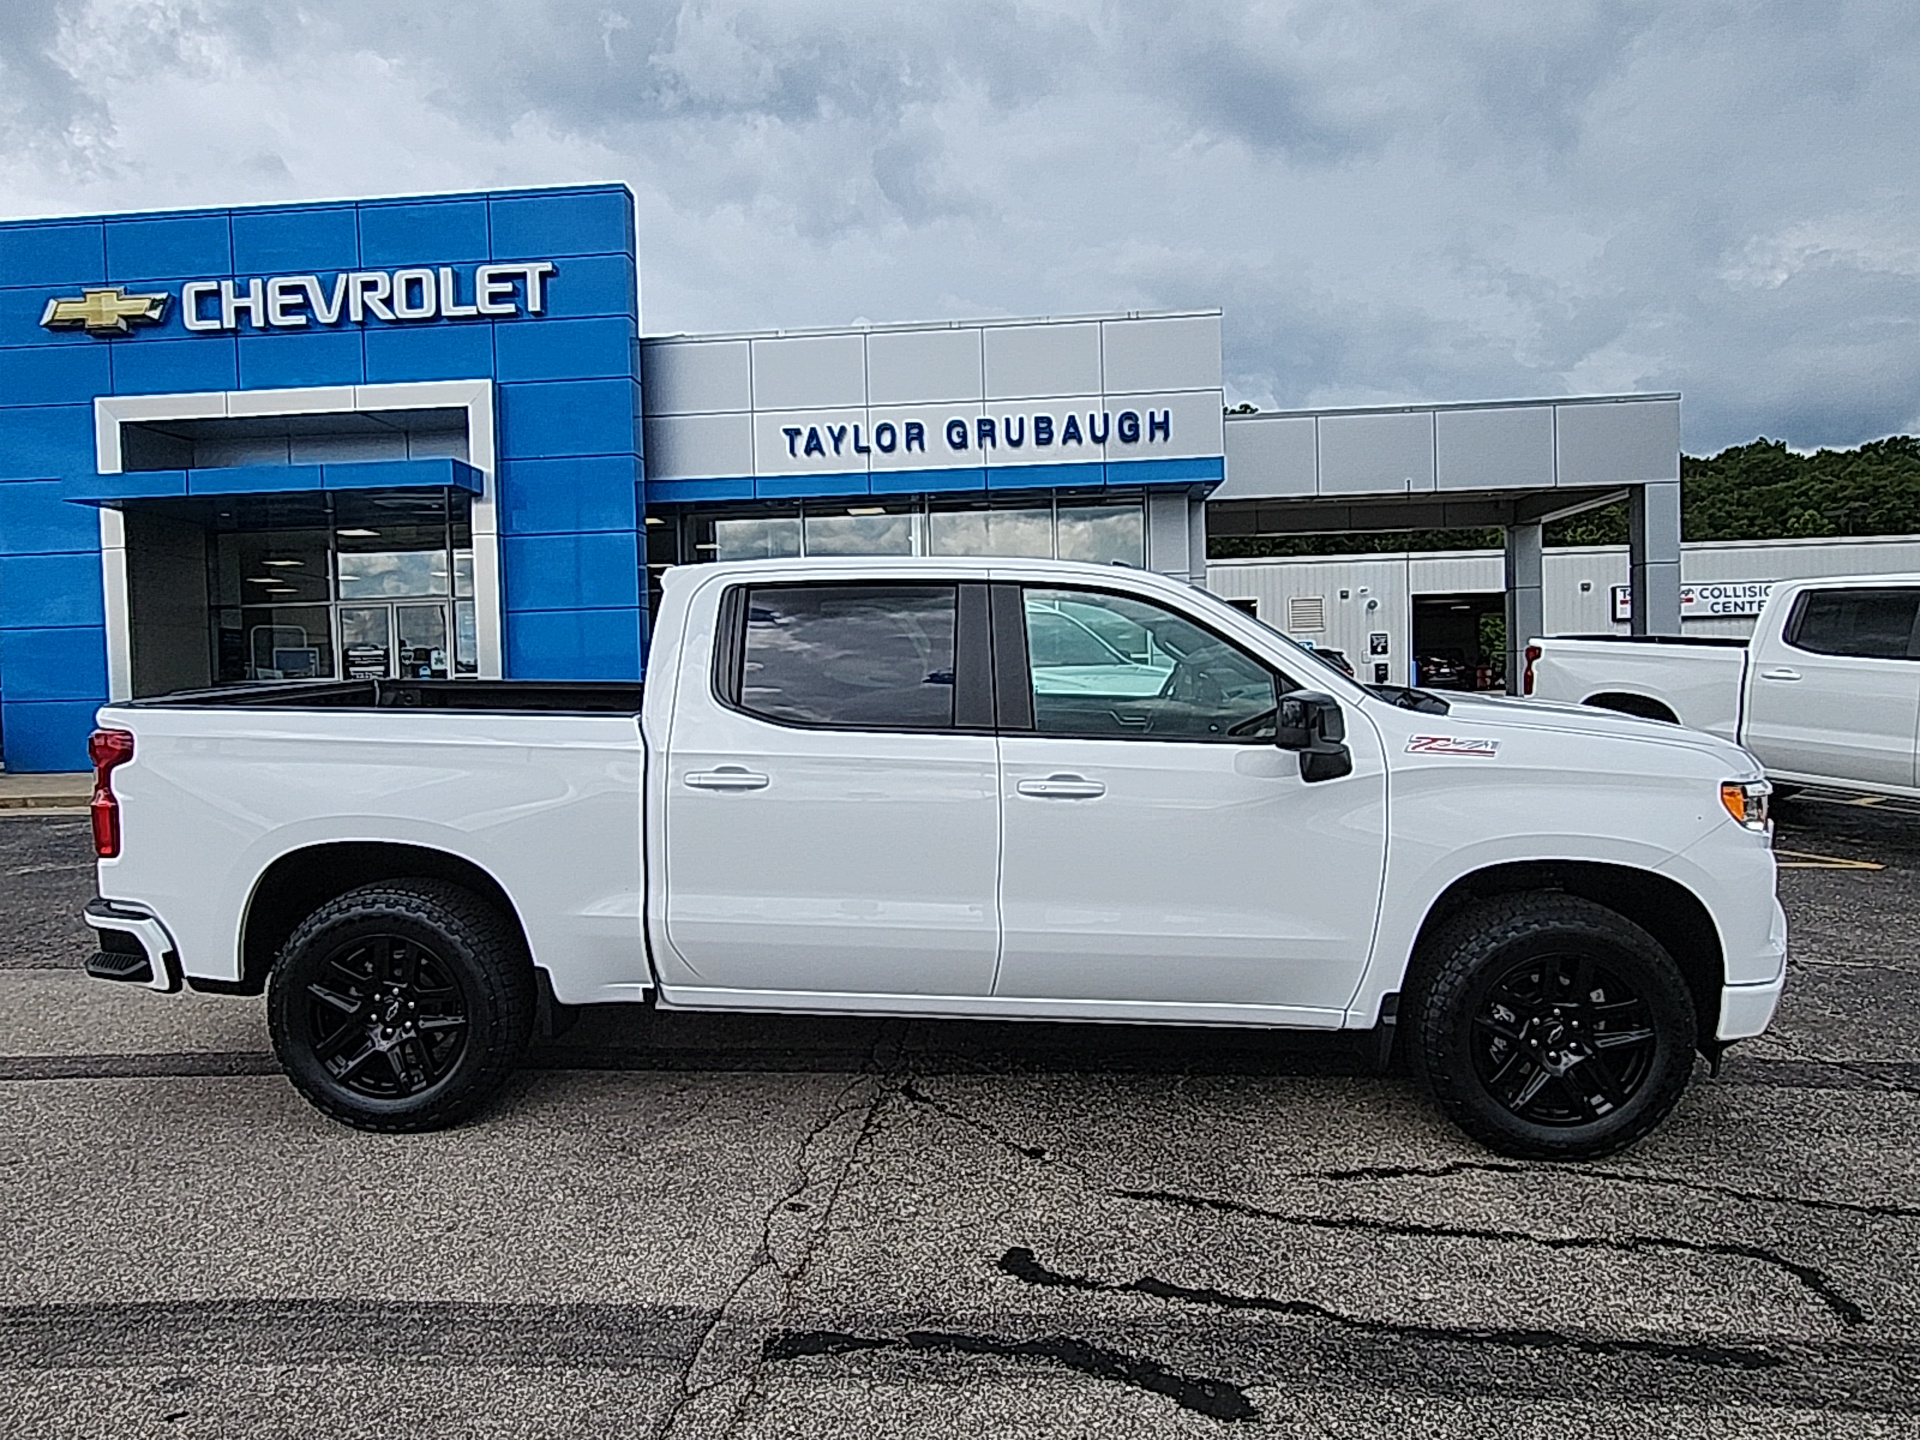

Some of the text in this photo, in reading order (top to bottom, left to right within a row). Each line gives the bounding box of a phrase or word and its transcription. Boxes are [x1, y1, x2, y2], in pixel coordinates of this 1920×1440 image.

[182, 262, 554, 331] CHEVROLET
[782, 409, 1172, 458] TAYLOR GRUBAUGH
[1699, 585, 1773, 600] COLLISIO
[1710, 600, 1767, 614] CENTE
